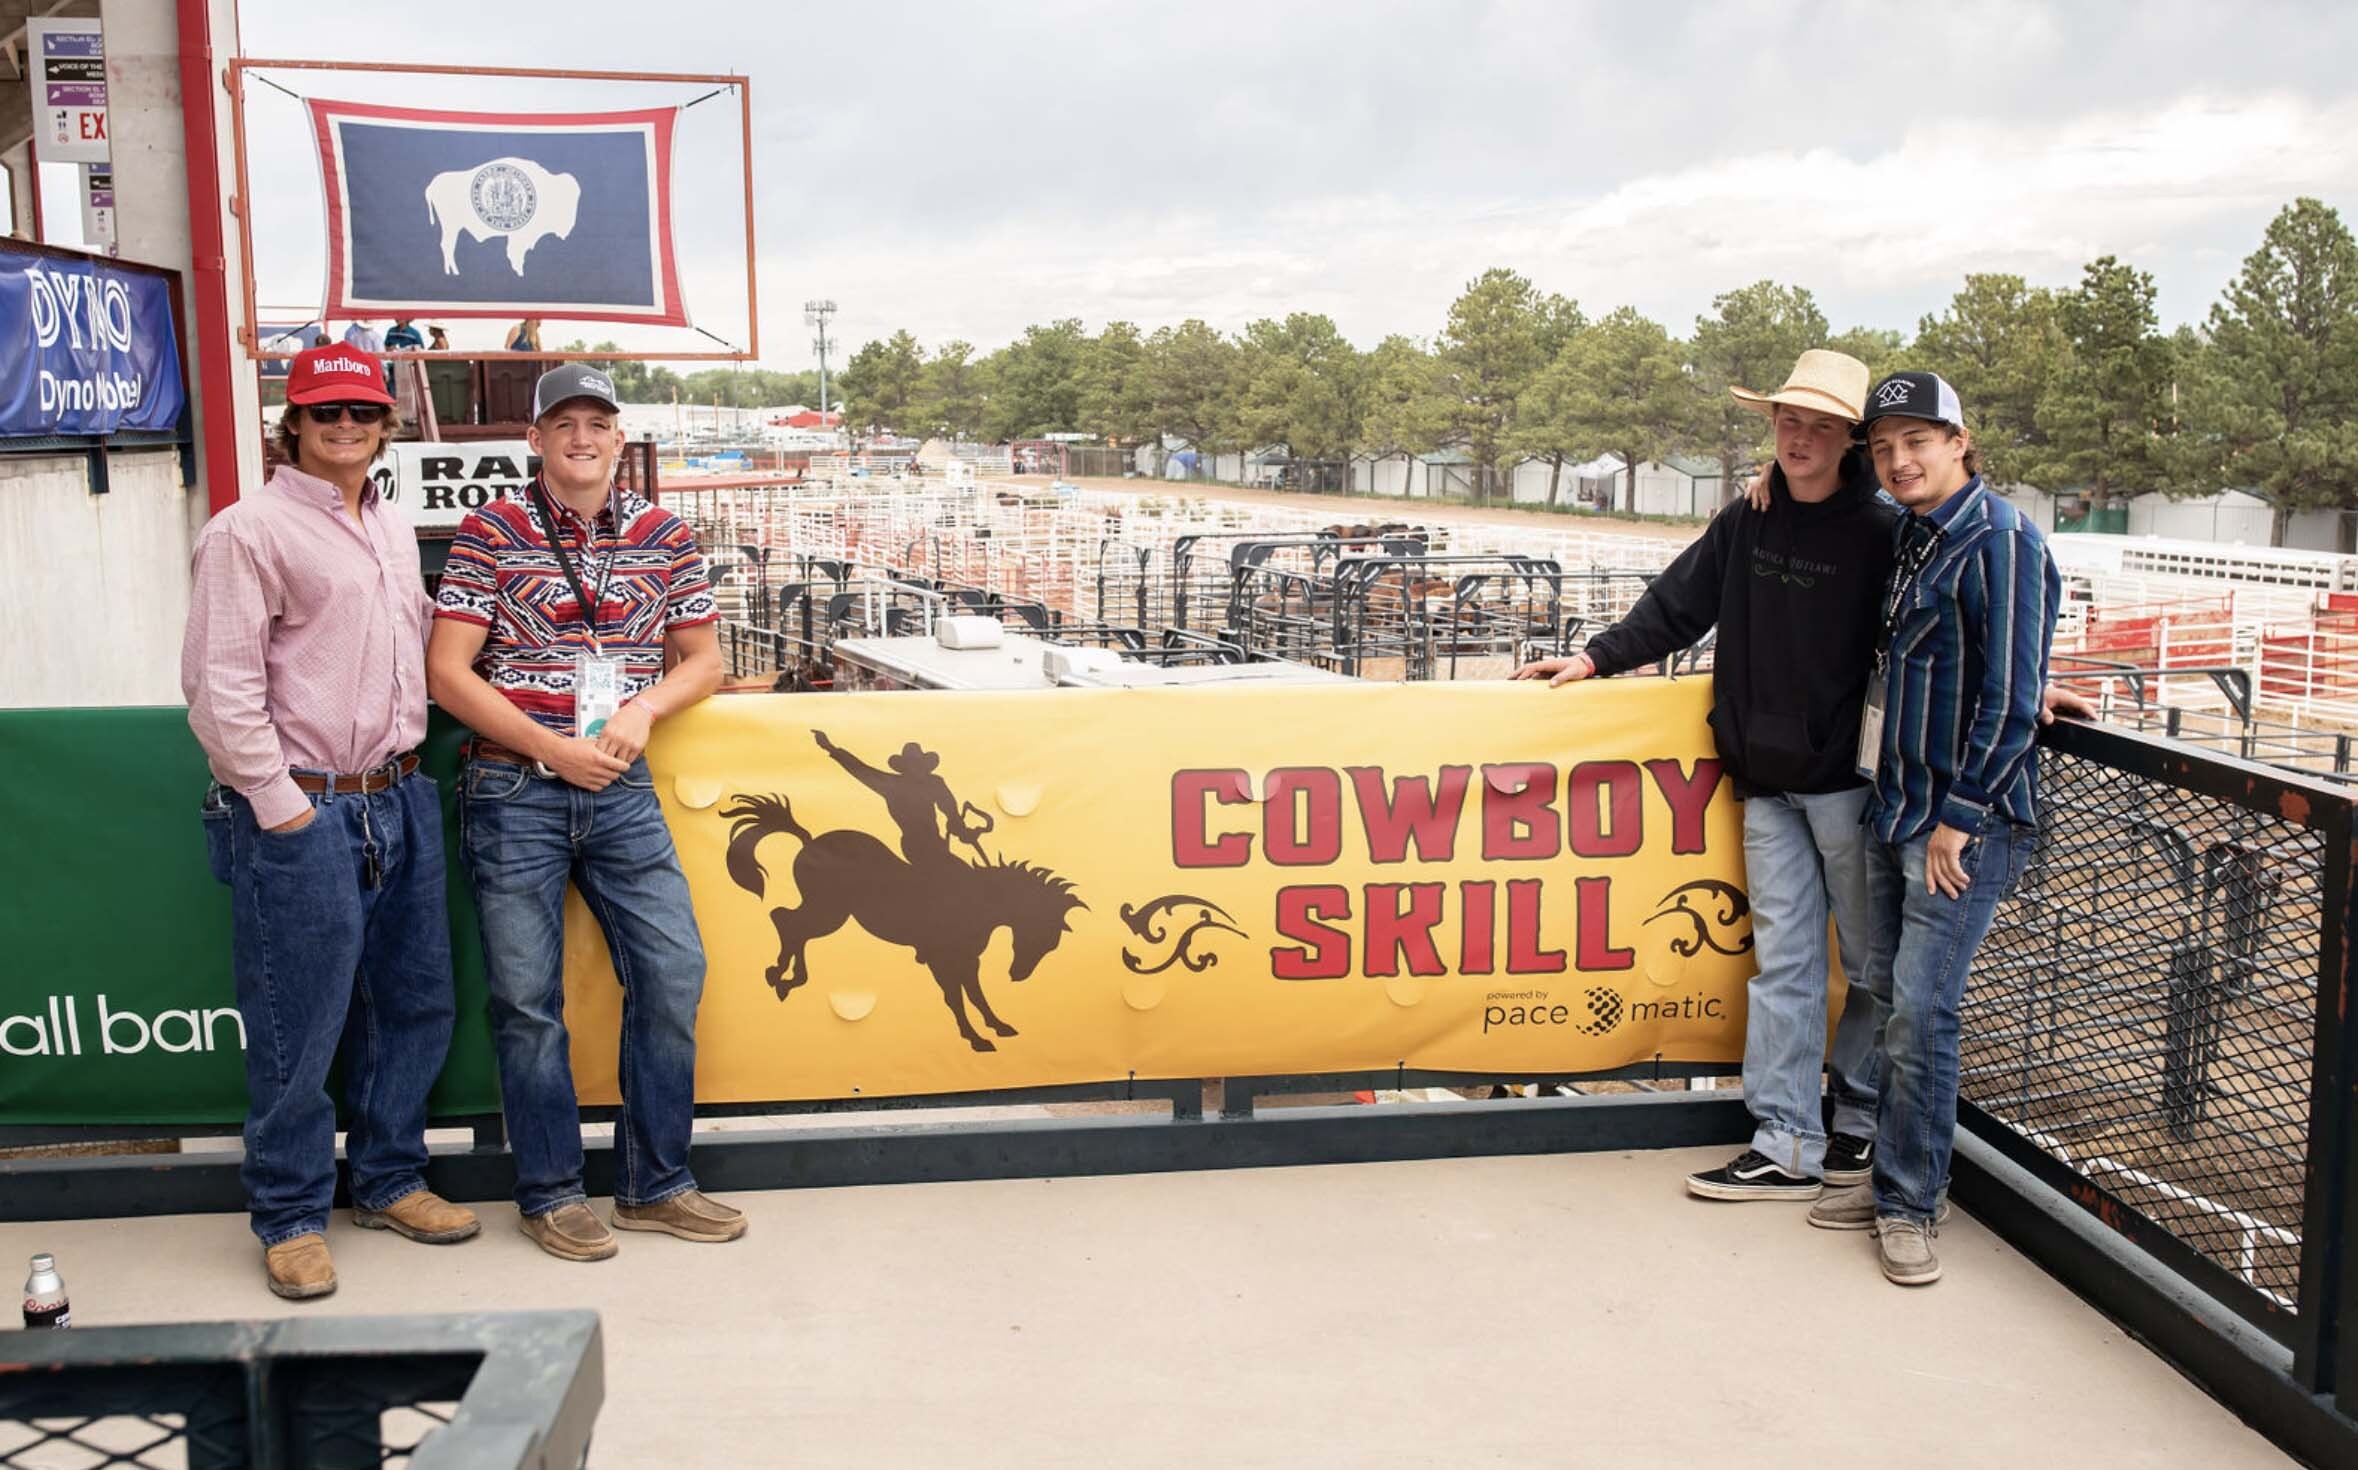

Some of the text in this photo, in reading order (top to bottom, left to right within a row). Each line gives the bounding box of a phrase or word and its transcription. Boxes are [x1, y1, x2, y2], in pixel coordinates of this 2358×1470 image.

[24, 269, 132, 353] DYNO
[313, 357, 371, 377] Marlboro
[1171, 757, 1724, 869] COWBOY
[1269, 876, 1635, 980] SKILL
[0, 994, 247, 1056] all ban
[1484, 1004, 1569, 1034] pace
[1486, 989, 1549, 1002] powered by
